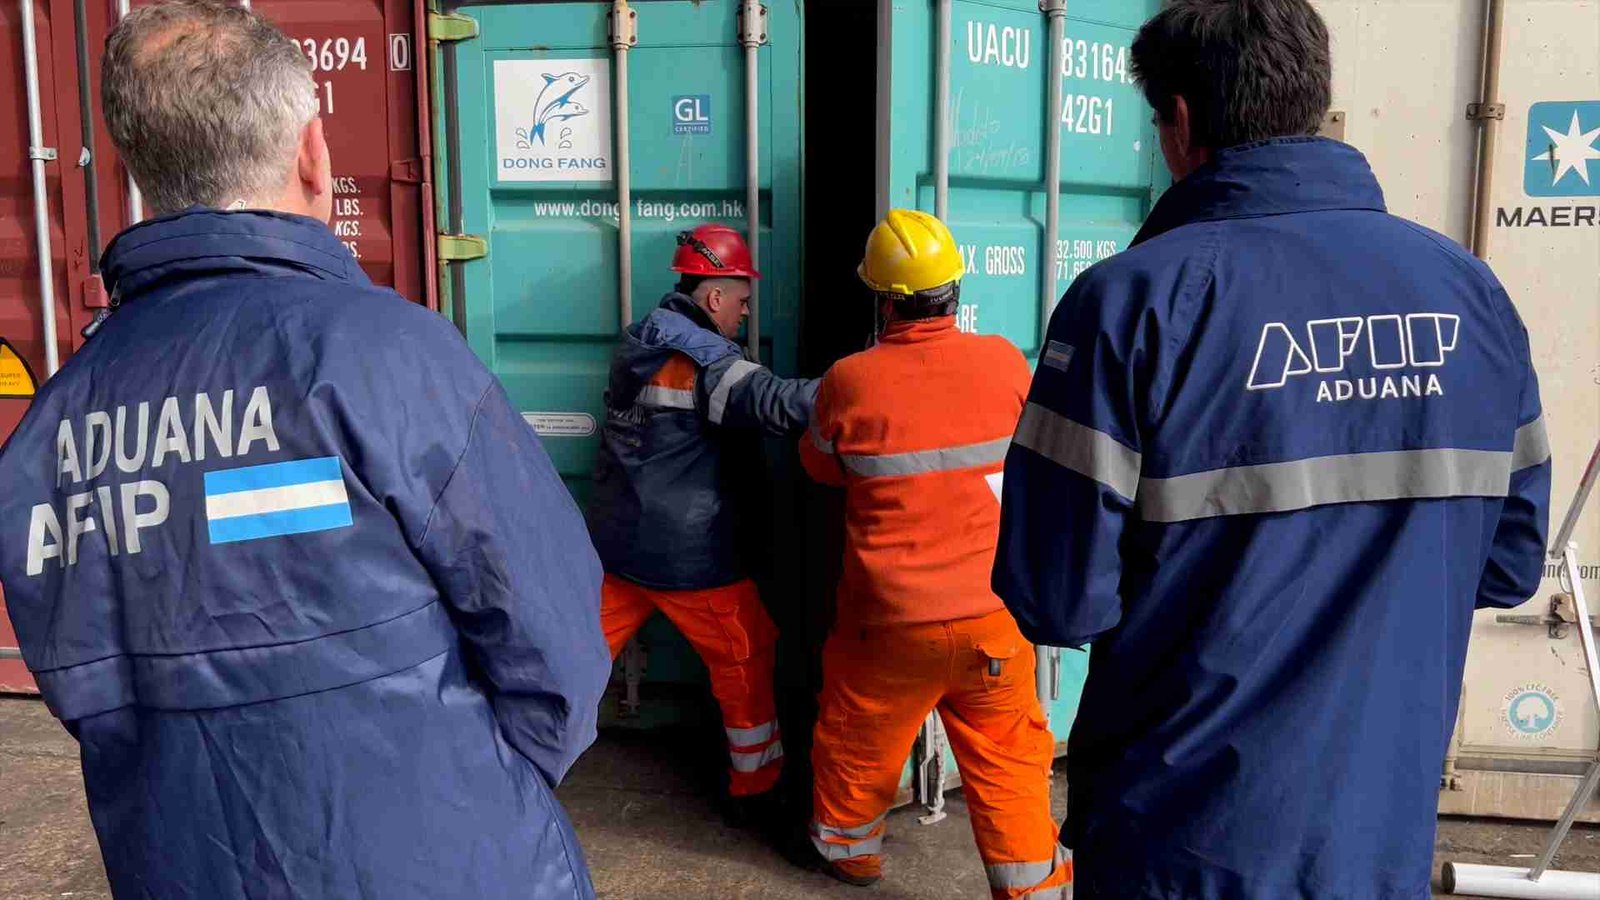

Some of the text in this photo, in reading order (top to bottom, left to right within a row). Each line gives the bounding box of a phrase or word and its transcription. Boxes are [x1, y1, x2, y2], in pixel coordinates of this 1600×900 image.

[290, 35, 408, 72] 3694 0
[967, 21, 1137, 85] UACU 83164
[675, 98, 709, 122] GL
[1062, 94, 1113, 136] 42G1
[503, 158, 607, 169] DONG FANG
[336, 199, 364, 216] LBS.
[1496, 206, 1600, 227] MAER
[334, 221, 362, 237] KGS.
[985, 245, 1025, 275] GROSS
[1246, 312, 1461, 391] AFIP
[1316, 373, 1444, 402] ADUANA
[56, 386, 281, 488] ADUANA
[26, 480, 171, 577] AFIP
